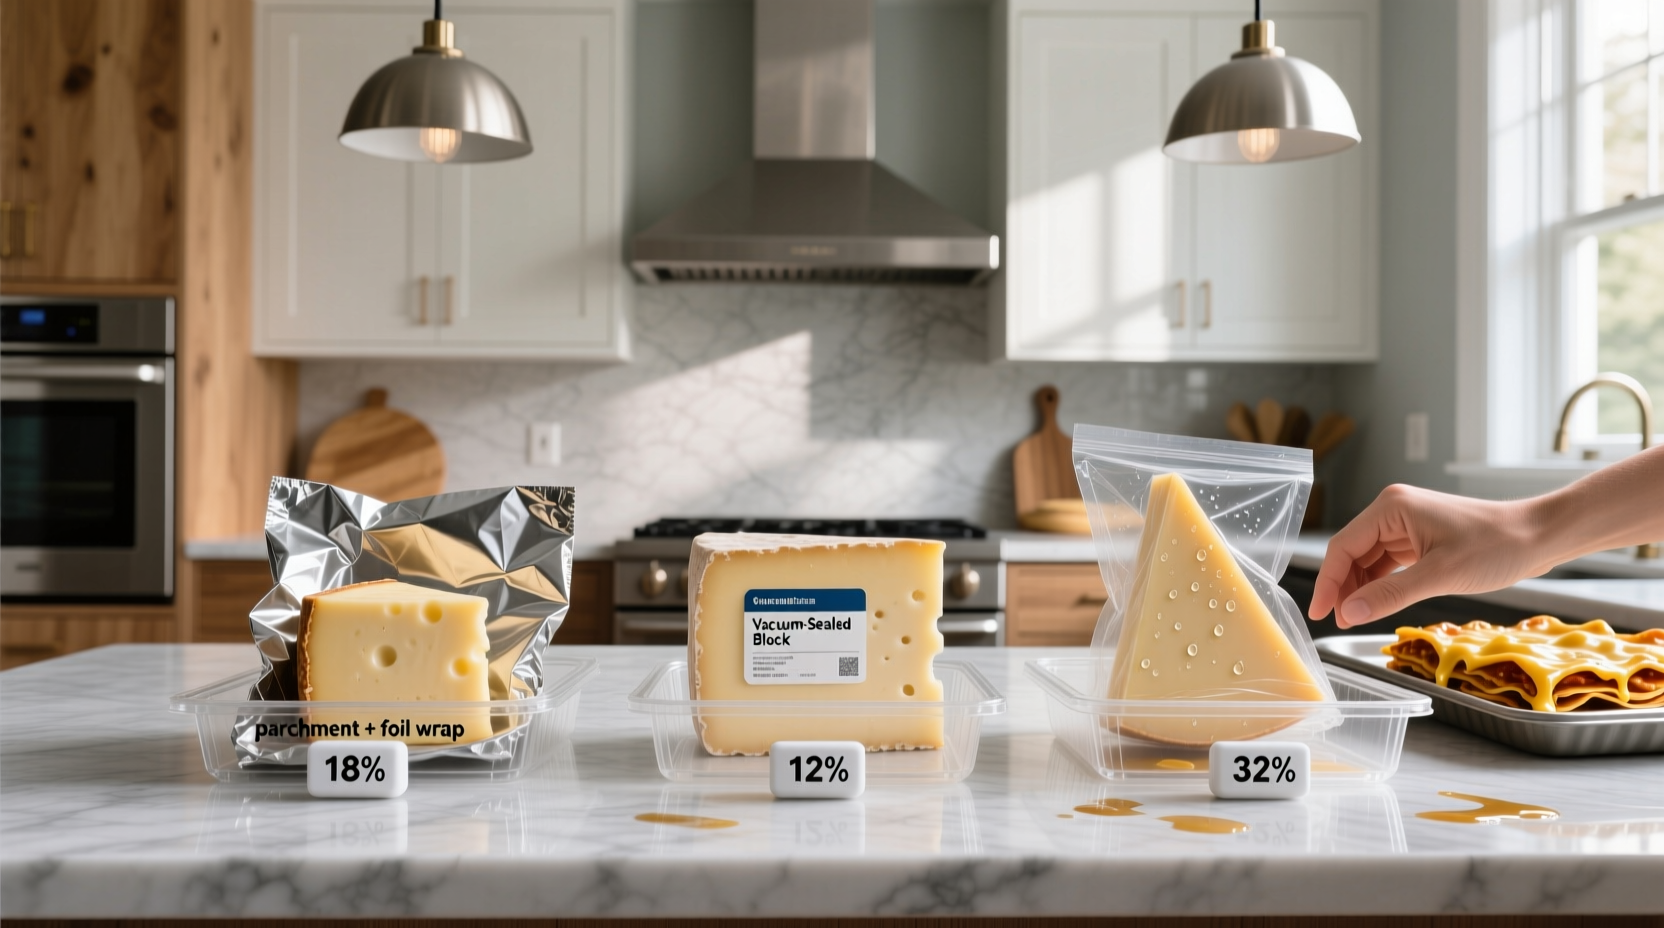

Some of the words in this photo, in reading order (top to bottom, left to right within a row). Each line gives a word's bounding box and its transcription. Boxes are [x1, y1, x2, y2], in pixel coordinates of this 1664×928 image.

[753, 632, 791, 646] Block
[255, 718, 360, 742] parchment
[364, 725, 376, 736] +
[380, 719, 410, 737] foil
[416, 723, 465, 742] wrap
[325, 754, 386, 783] 18%
[789, 755, 849, 783] 12%
[1233, 755, 1296, 783] 32%
